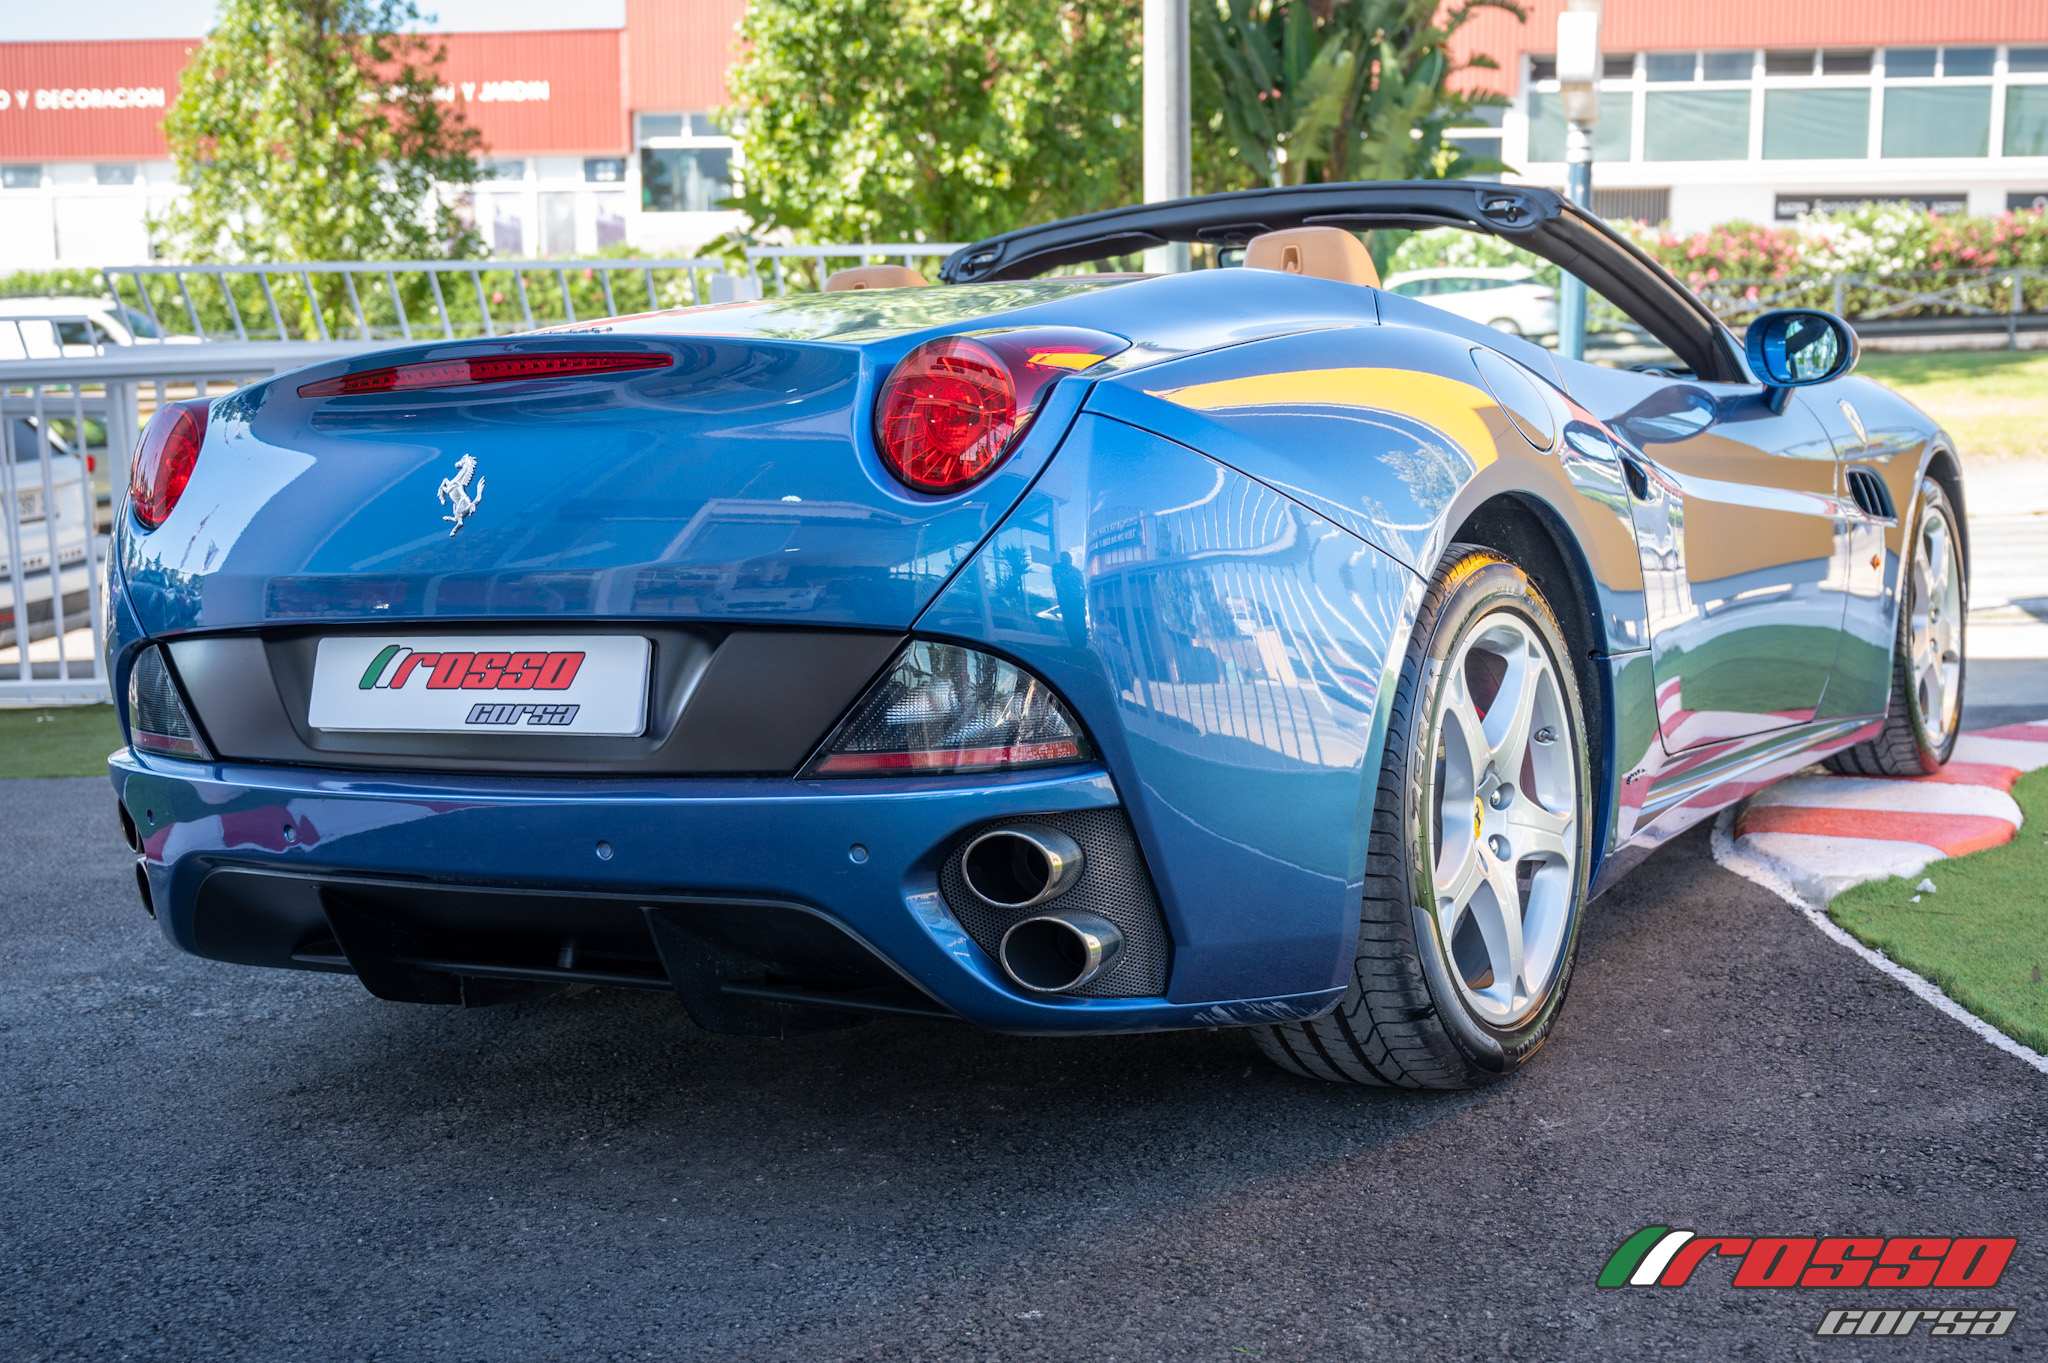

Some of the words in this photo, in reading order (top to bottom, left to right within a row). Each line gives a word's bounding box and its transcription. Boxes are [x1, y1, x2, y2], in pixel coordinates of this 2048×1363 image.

[14, 89, 29, 110] Y
[35, 87, 165, 110] DECORACION
[460, 81, 476, 102] Y
[390, 651, 585, 690] rosso
[465, 703, 580, 725] corsa
[1412, 684, 1435, 826] ZERO
